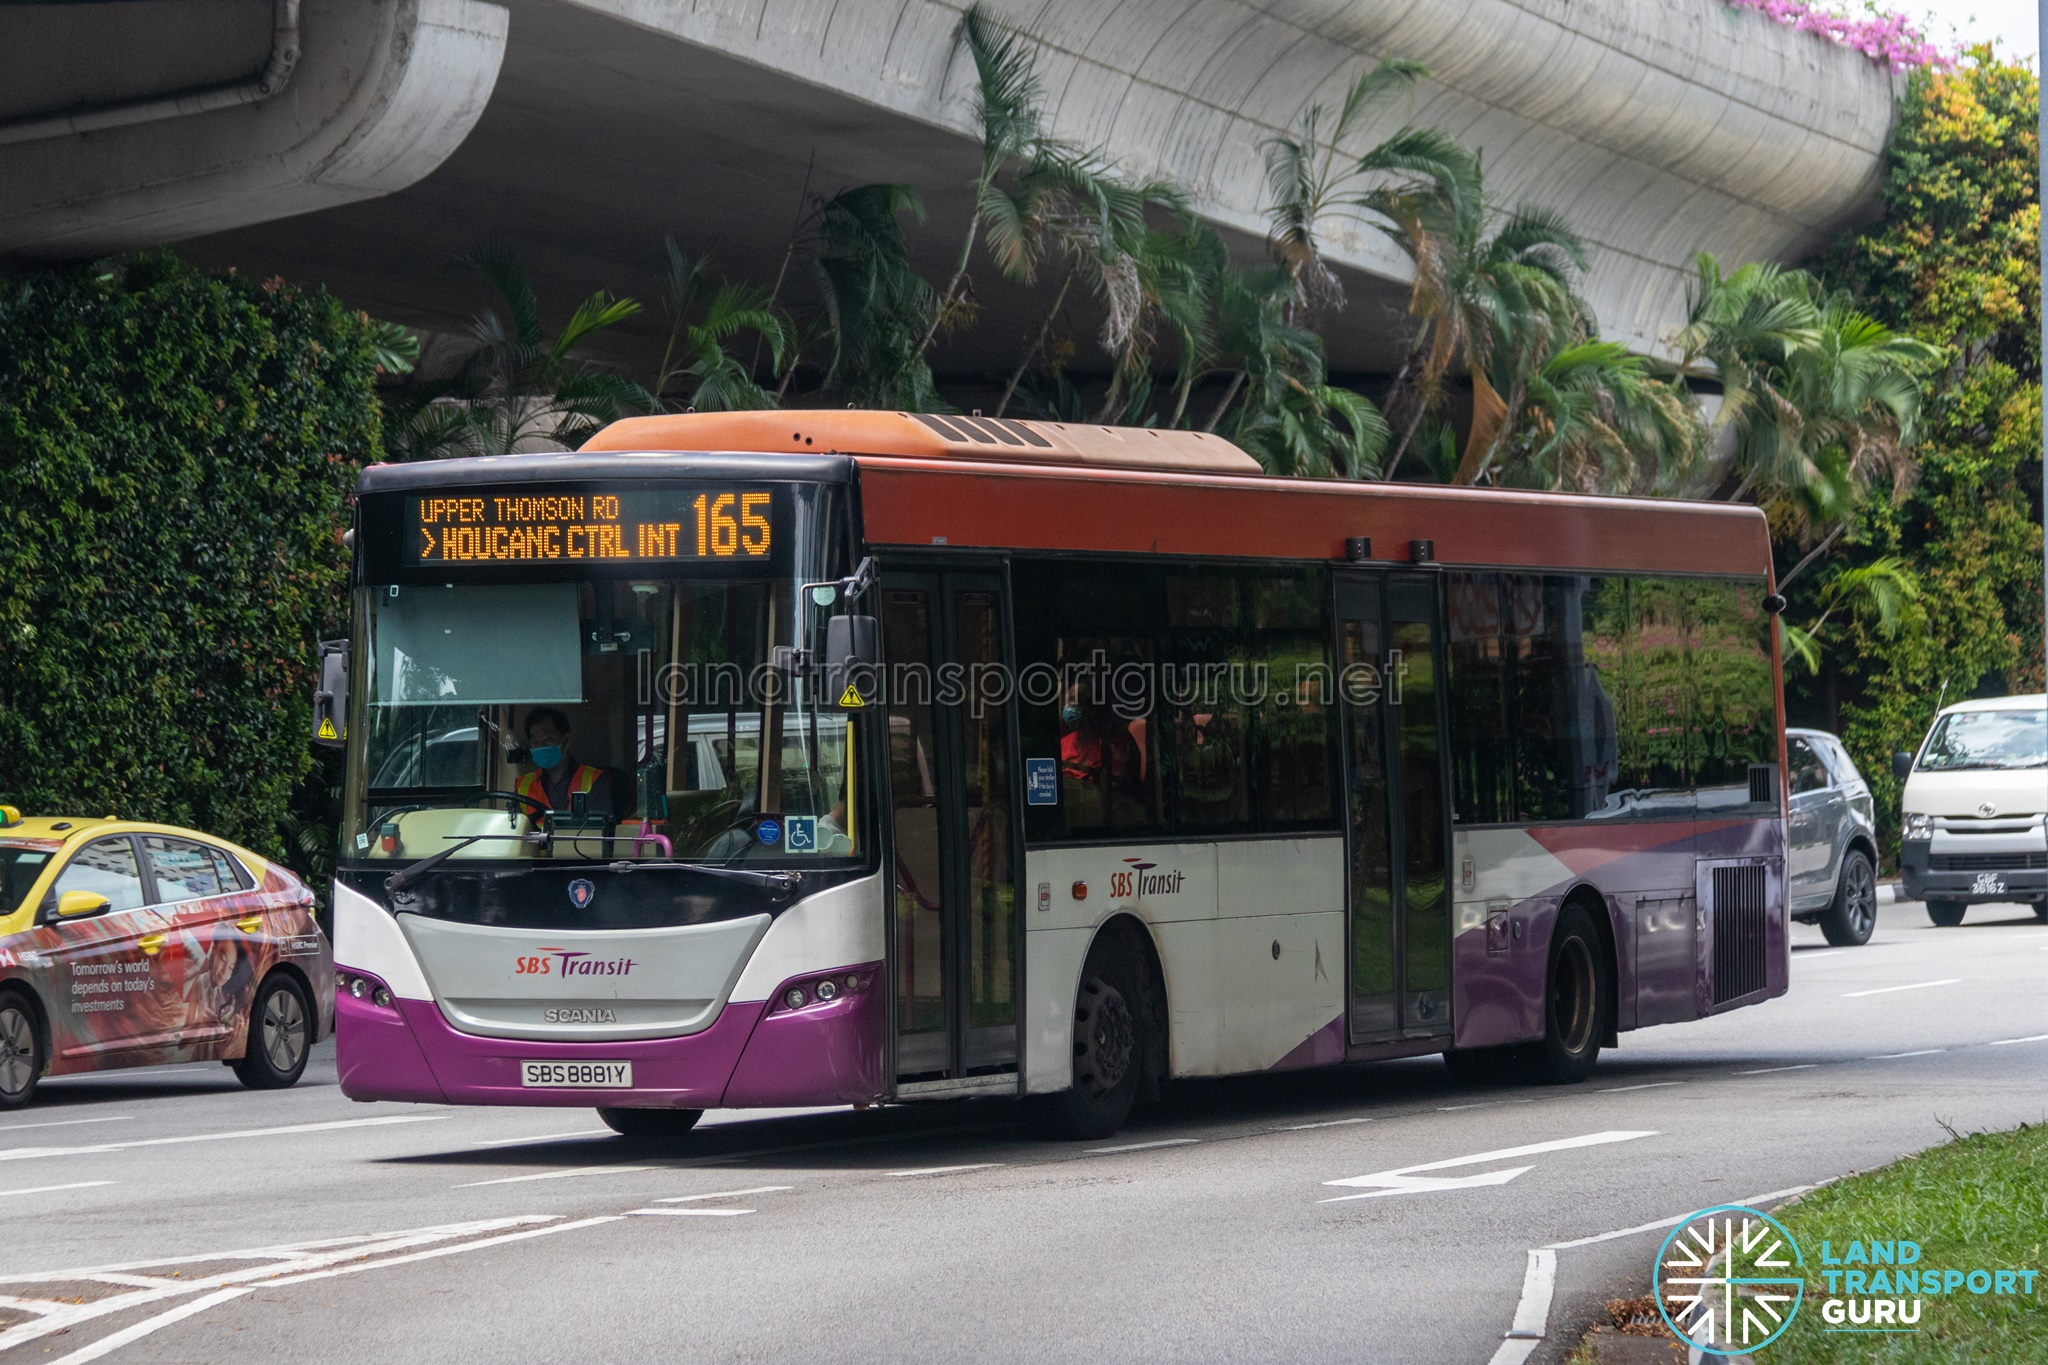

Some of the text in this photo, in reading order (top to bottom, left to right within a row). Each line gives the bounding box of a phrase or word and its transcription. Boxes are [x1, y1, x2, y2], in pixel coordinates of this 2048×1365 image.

[420, 496, 619, 522] UPPER THOMSON RD
[693, 493, 771, 556] 165
[442, 523, 680, 560] HOUGANG CTRL INT
[1109, 863, 1187, 901] SBS Transit
[16, 951, 39, 962] HSBC
[69, 958, 150, 976] Tomorrow's world
[515, 952, 640, 979] SBS Transit
[71, 976, 155, 998] depends on today's
[71, 999, 125, 1014] investments
[544, 1008, 617, 1024] SCANIA
[526, 1064, 626, 1084] SBS8881Y
